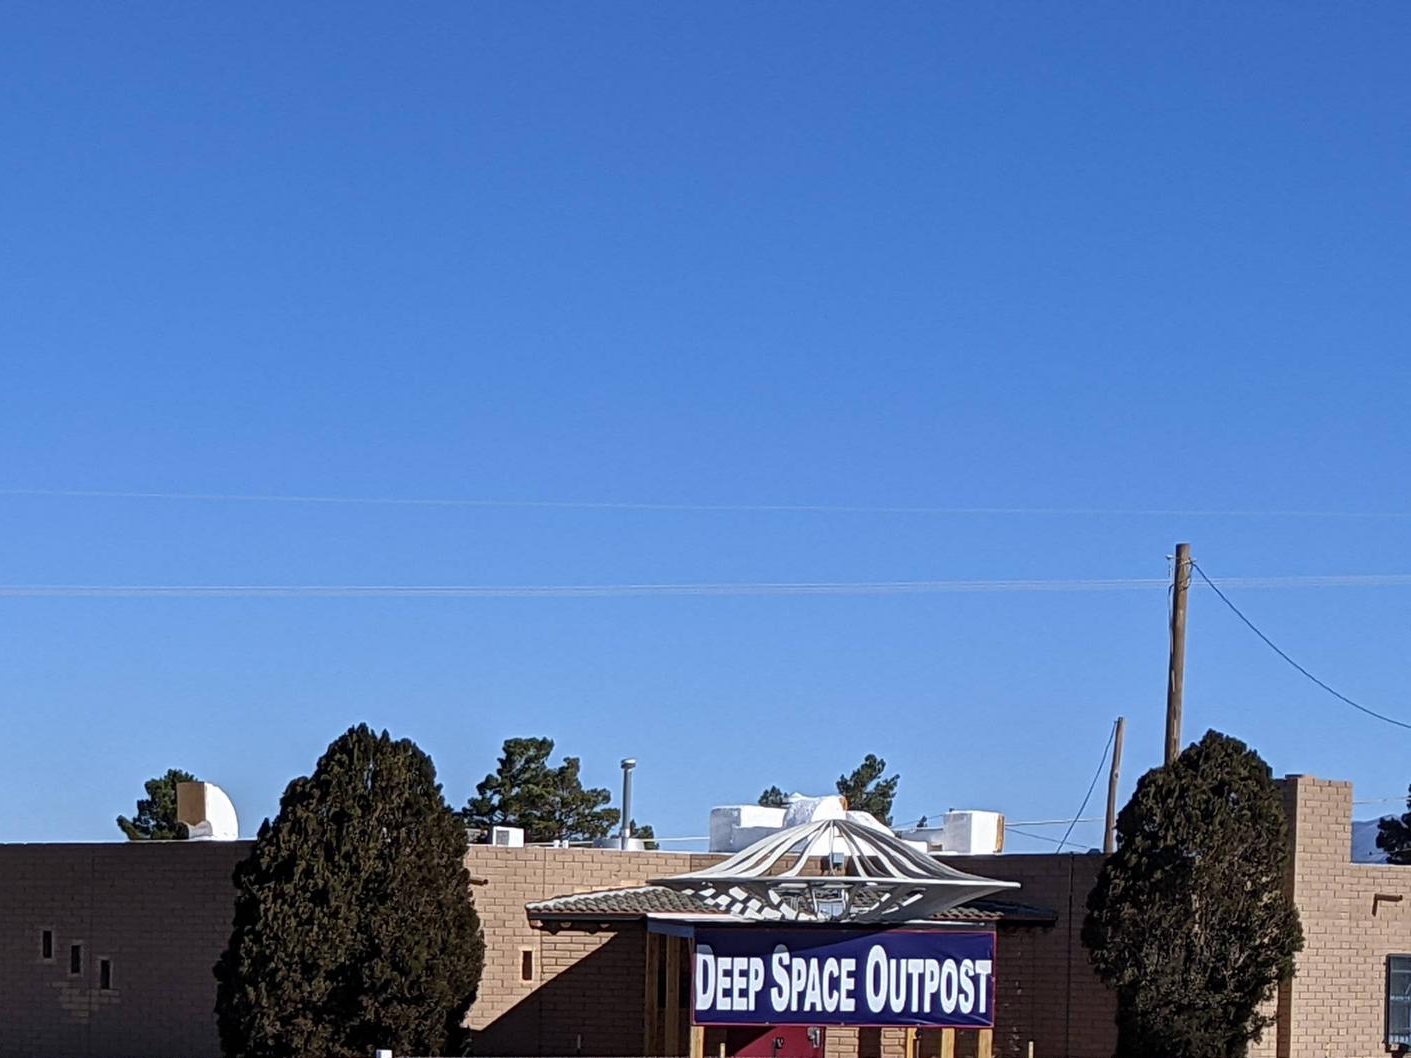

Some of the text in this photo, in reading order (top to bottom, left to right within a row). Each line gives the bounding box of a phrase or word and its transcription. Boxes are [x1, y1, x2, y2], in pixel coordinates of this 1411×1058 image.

[694, 943, 992, 1014] DEEP SPACE OUTPOST
